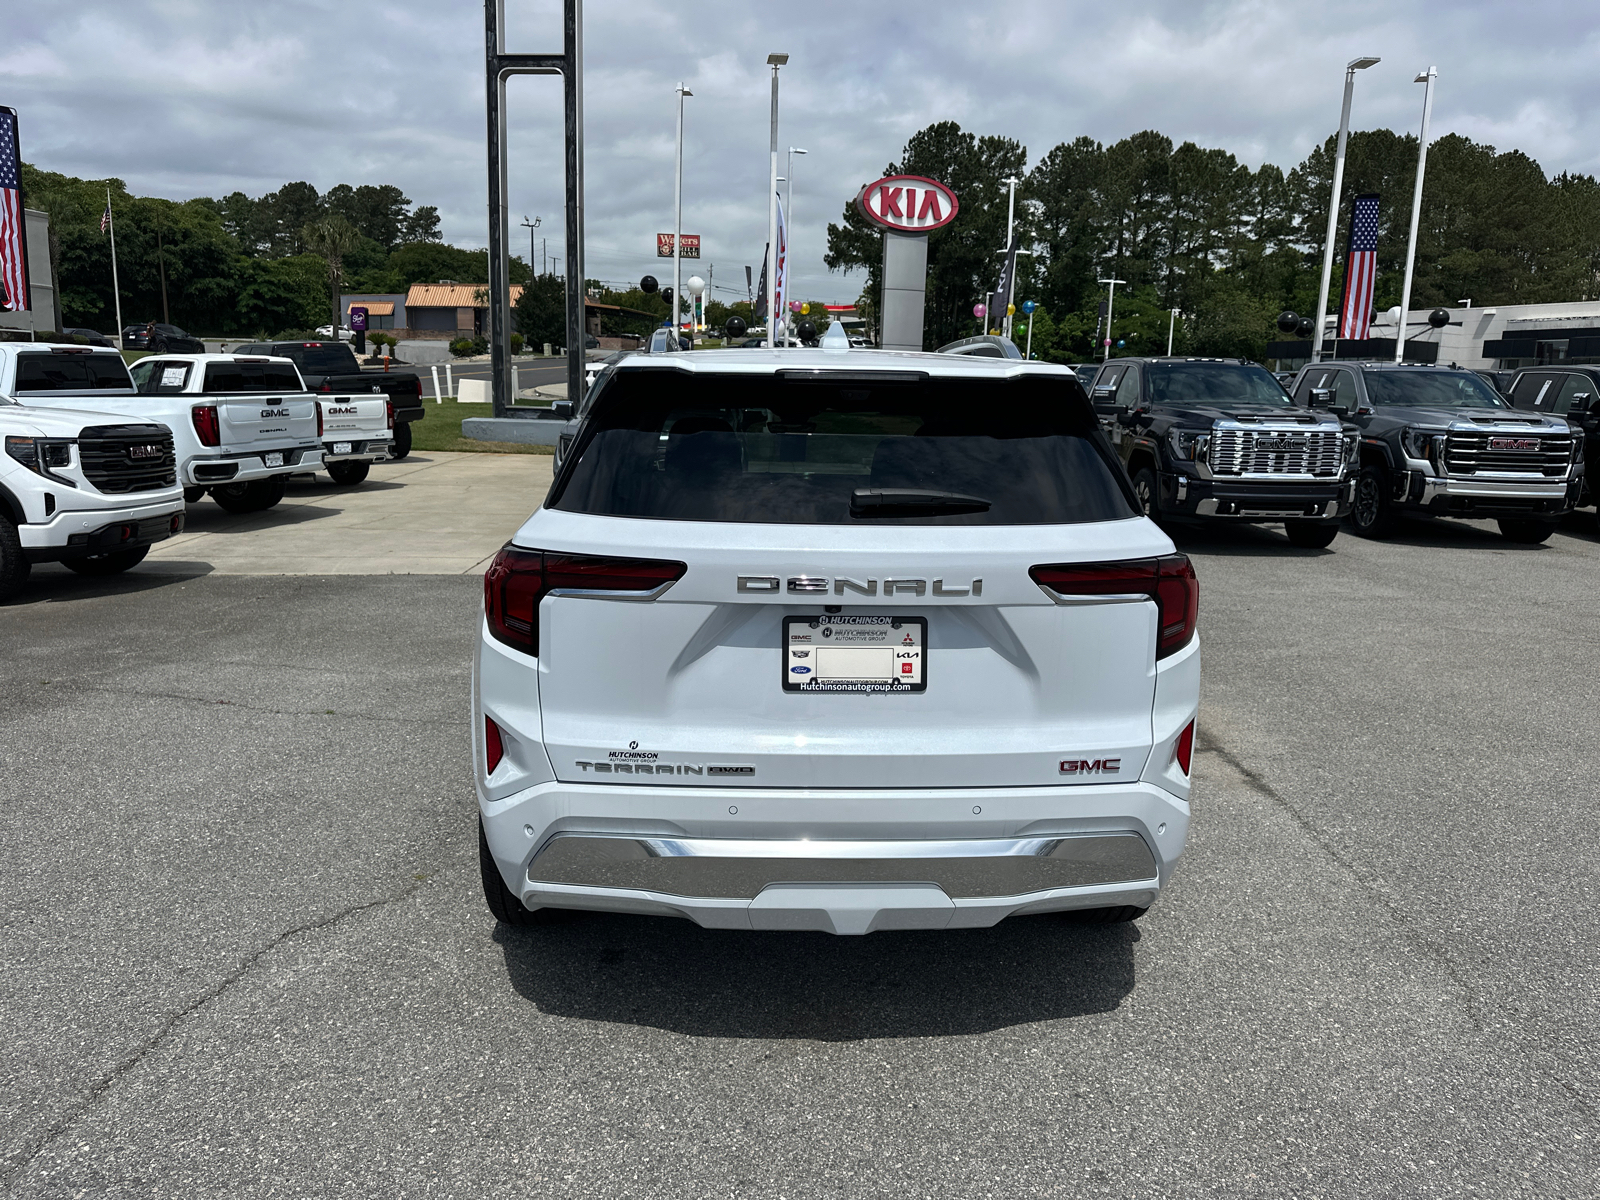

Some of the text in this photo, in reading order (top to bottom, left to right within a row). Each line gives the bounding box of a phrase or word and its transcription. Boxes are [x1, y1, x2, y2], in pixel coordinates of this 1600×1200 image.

[880, 186, 942, 220] KIA
[660, 235, 698, 246] Waers
[261, 409, 290, 418] GMC
[1258, 439, 1306, 449] GMC
[1492, 439, 1538, 449] GMC
[130, 445, 163, 458] GMC
[737, 575, 983, 597] DENALI
[830, 616, 892, 625] HUTCHINSON
[800, 683, 911, 692] Hutchinsonautogroup.com
[608, 751, 659, 759] HUTCHINSON
[575, 761, 703, 776] TERRAIN
[1059, 758, 1121, 773] GMC
